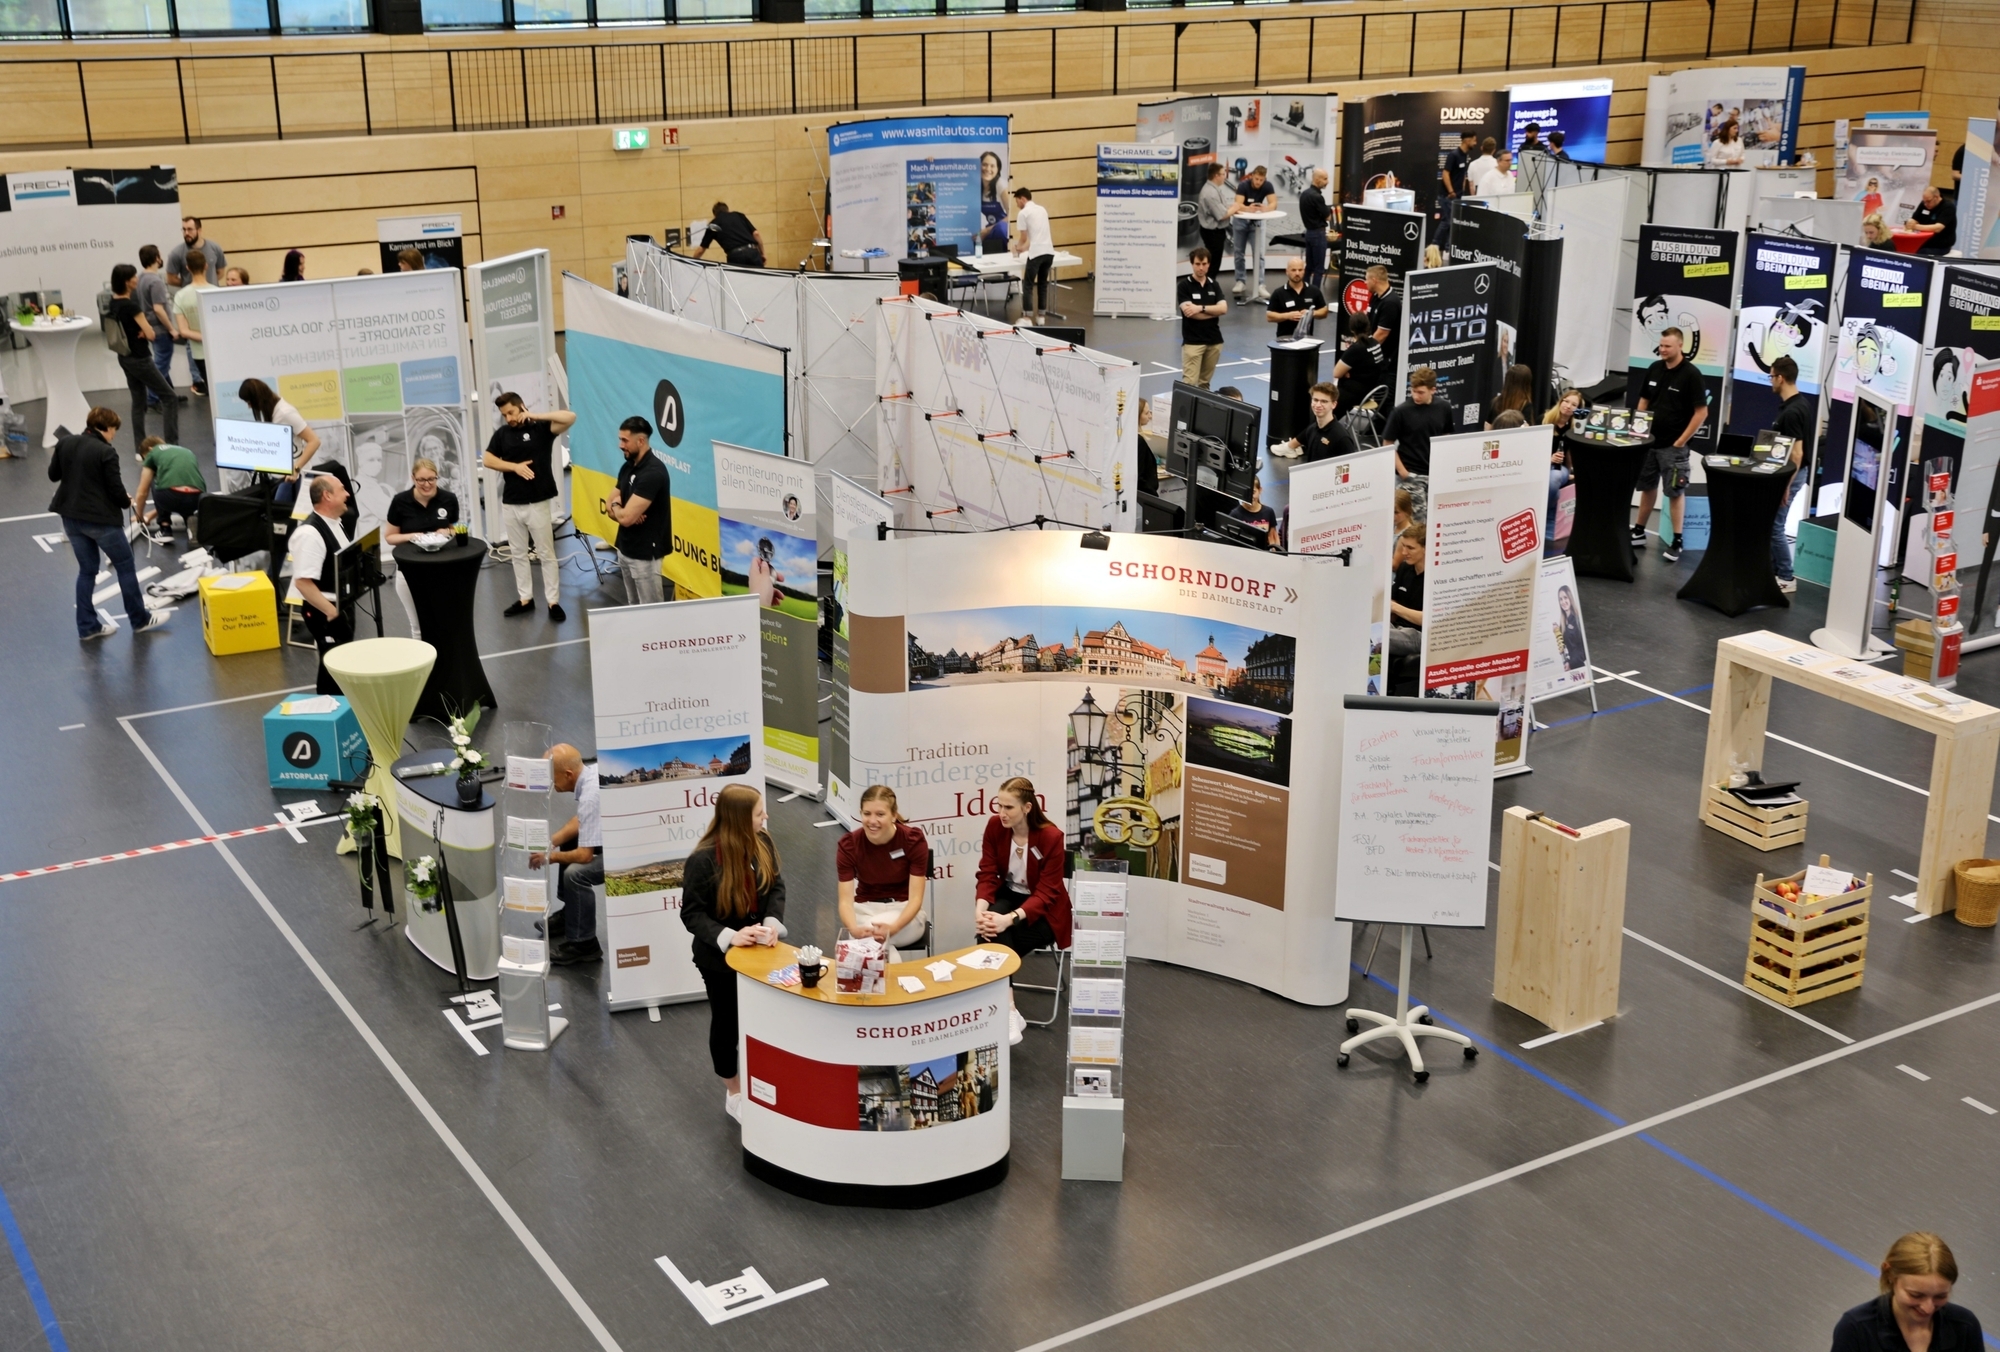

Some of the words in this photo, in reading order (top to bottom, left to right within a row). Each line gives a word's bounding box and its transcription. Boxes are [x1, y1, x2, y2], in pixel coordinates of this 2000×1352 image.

[1515, 109, 1549, 119] Unterwegs
[1550, 108, 1557, 117] in
[881, 125, 1003, 140] www.wasmitautos.com
[910, 164, 928, 173] Mach
[929, 162, 977, 172] #wasmitautos
[12, 180, 70, 191] FRECH
[1111, 188, 1131, 196] wollen
[1131, 188, 1141, 196] Sie
[421, 221, 455, 229] FRECH
[40, 242, 57, 253] aus
[59, 240, 88, 252] einem
[90, 239, 114, 249] Guss
[414, 240, 427, 250] fest
[428, 239, 436, 249] im
[436, 239, 455, 250] Blick!
[1346, 238, 1359, 250] Das
[1359, 240, 1379, 254] Burger
[1380, 243, 1402, 256] Schloz
[1653, 241, 1720, 256] AUSBILDUNG
[1345, 249, 1393, 266] Jobversprechen.
[1451, 244, 1473, 261] Unser
[1685, 255, 1708, 265] AMT
[1759, 249, 1818, 268] AUSBILDUNG
[1786, 265, 1808, 277] AMT
[1863, 266, 1903, 283] STUDIUM
[1888, 282, 1909, 294] AMT
[1952, 286, 2000, 308] AUSBILDUNG
[1410, 303, 1488, 325] MISSION
[1974, 305, 1991, 317] AMT
[1409, 318, 1487, 346] AUTO
[1429, 360, 1436, 370] in
[1437, 358, 1456, 369] unser
[1457, 354, 1475, 367] Team!
[227, 435, 266, 448] Maschinen-
[267, 440, 281, 448] und
[230, 444, 278, 456] Anlagenführer
[721, 457, 784, 489] Orientierung
[786, 476, 804, 490] mit
[1456, 464, 1482, 474] BIBER
[1483, 459, 1524, 471] HOLZBAU
[721, 473, 746, 491] allen
[748, 479, 782, 499] Sinnen
[1312, 490, 1335, 501] BIBER
[1336, 482, 1371, 496] HOLZBAU
[1437, 500, 1471, 510] Zimmerer
[1501, 521, 1519, 532] Werde
[1521, 514, 1532, 524] mit
[1300, 529, 1337, 544] BEWUSST
[1337, 523, 1363, 536] BAUEN
[1503, 534, 1519, 544] einer
[1519, 526, 1534, 537] echt
[1507, 527, 1519, 536] uns
[1300, 540, 1336, 554] BEWUSST
[1337, 534, 1361, 546] LEBEN
[1510, 536, 1528, 549] guten
[1109, 561, 1276, 599] SCHORNDORF
[1433, 578, 1448, 586] Was
[1448, 576, 1457, 584] du
[1458, 571, 1486, 582] schaffen
[1487, 569, 1504, 578] wirst:
[1179, 588, 1198, 598] DIE
[1201, 592, 1284, 616] DAIMLERSTADT
[222, 614, 238, 623] Your
[239, 613, 260, 622] Tape.
[222, 622, 237, 632] Our
[238, 620, 267, 630] Passion.
[642, 634, 734, 652] SCHORNDORF
[691, 644, 739, 654] DAIMLERSTADT
[1428, 667, 1449, 678] Azubi,
[1449, 664, 1474, 674] Geselle
[1475, 661, 1491, 669] oder
[1491, 655, 1521, 667] Meister?
[1427, 672, 1457, 684] Bewerbung
[645, 697, 711, 713] Tradition
[618, 709, 750, 738] Erfindergeist
[1360, 729, 1399, 753] Erzieher
[906, 741, 990, 762] Tradition
[1411, 750, 1486, 768] Fachinformatiker
[279, 772, 329, 781] ASTORPLAST
[865, 757, 1036, 790] Erfindergeist
[1191, 775, 1223, 788] Sehenswert.
[1357, 779, 1394, 791] Fachkraft
[683, 786, 721, 809] Ide
[954, 788, 1048, 817] Iden
[658, 813, 685, 826] Mut
[921, 822, 954, 837] Mut
[1365, 845, 1385, 856] BFD
[1191, 859, 1212, 869] Heimat
[1191, 866, 1206, 875] guter
[1206, 868, 1224, 878] Ideen.
[1404, 869, 1478, 884] Immobilienwirtschaft
[856, 1008, 983, 1040] SCHORNDORF
[911, 1037, 926, 1047] DIE
[928, 1021, 990, 1045] DAIMLERSTADT
[720, 1284, 747, 1300] 35
